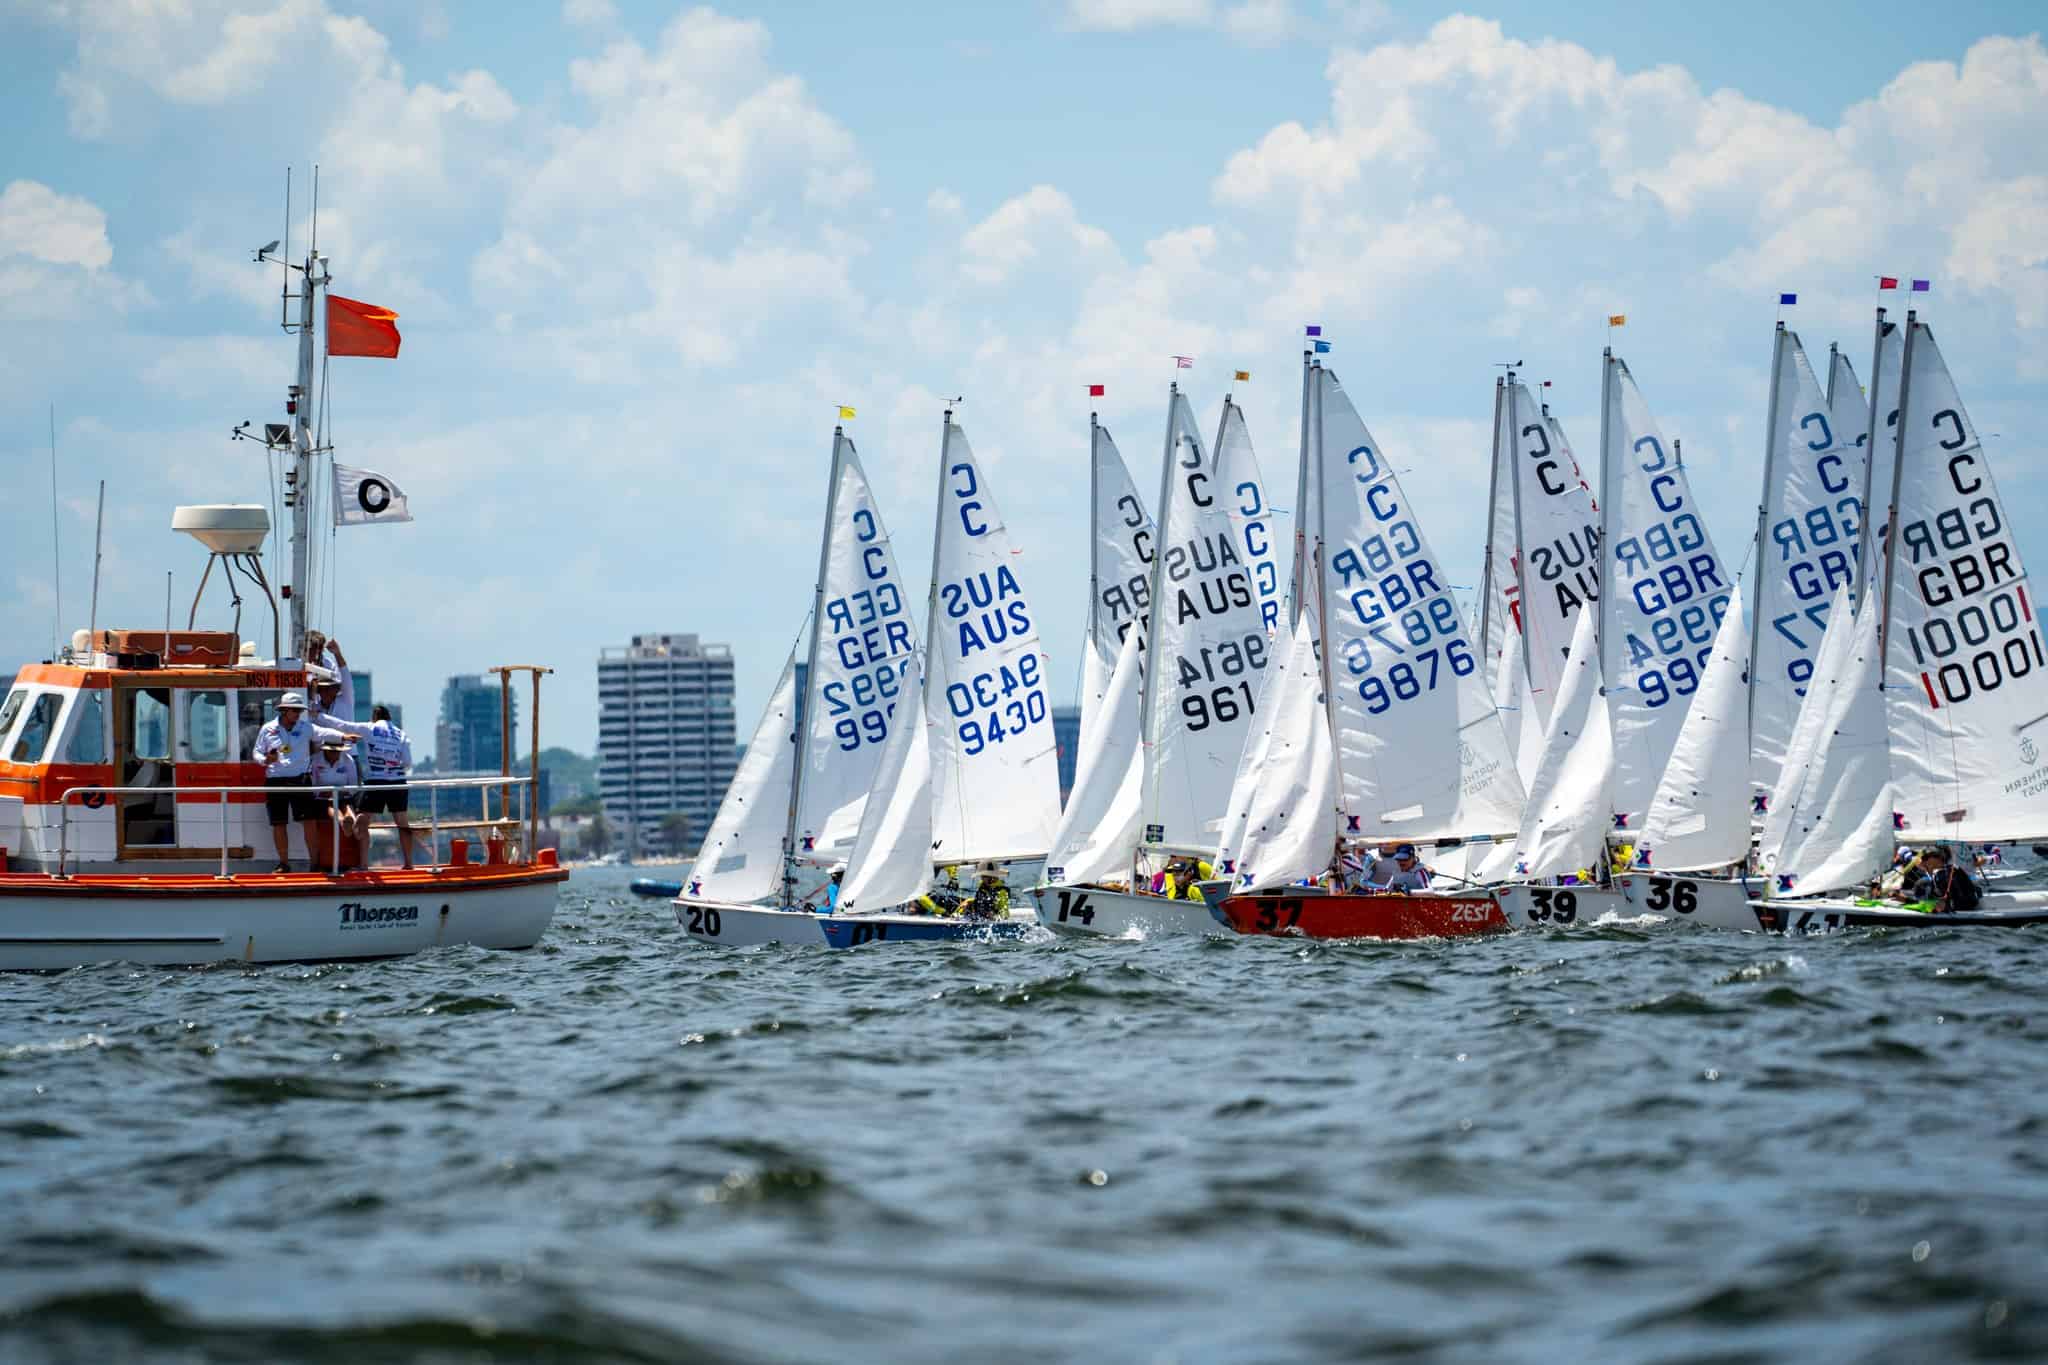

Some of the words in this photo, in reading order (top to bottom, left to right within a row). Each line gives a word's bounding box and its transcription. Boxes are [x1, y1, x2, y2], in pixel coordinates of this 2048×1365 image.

[1187, 472, 1213, 507] C
[1536, 460, 1566, 495] C
[1651, 475, 1683, 512] C
[1817, 454, 1849, 494] C
[1948, 454, 1982, 495] C
[960, 501, 987, 537] C
[1366, 485, 1397, 521] C
[1134, 531, 1154, 563] C
[1244, 522, 1268, 557] C
[863, 547, 888, 580] C
[1788, 543, 1858, 600] GB
[1918, 541, 2016, 608] GBR
[1178, 573, 1251, 625] AUS
[1351, 559, 1441, 624] GBR
[1555, 566, 1599, 619] AU
[1633, 554, 1723, 616] GBR
[837, 621, 912, 670] GER
[959, 601, 1032, 657] AUS
[1358, 639, 1475, 714] 9876
[1921, 629, 2045, 709] 10001
[958, 690, 1046, 756] 9430
[1181, 680, 1255, 732] 961
[835, 703, 897, 751] 99
[337, 902, 418, 923] Thorsen
[1058, 891, 1095, 925] 14
[1255, 900, 1303, 931] 37
[1528, 889, 1577, 924] 39
[1646, 877, 1699, 914] 36
[687, 905, 721, 937] 20
